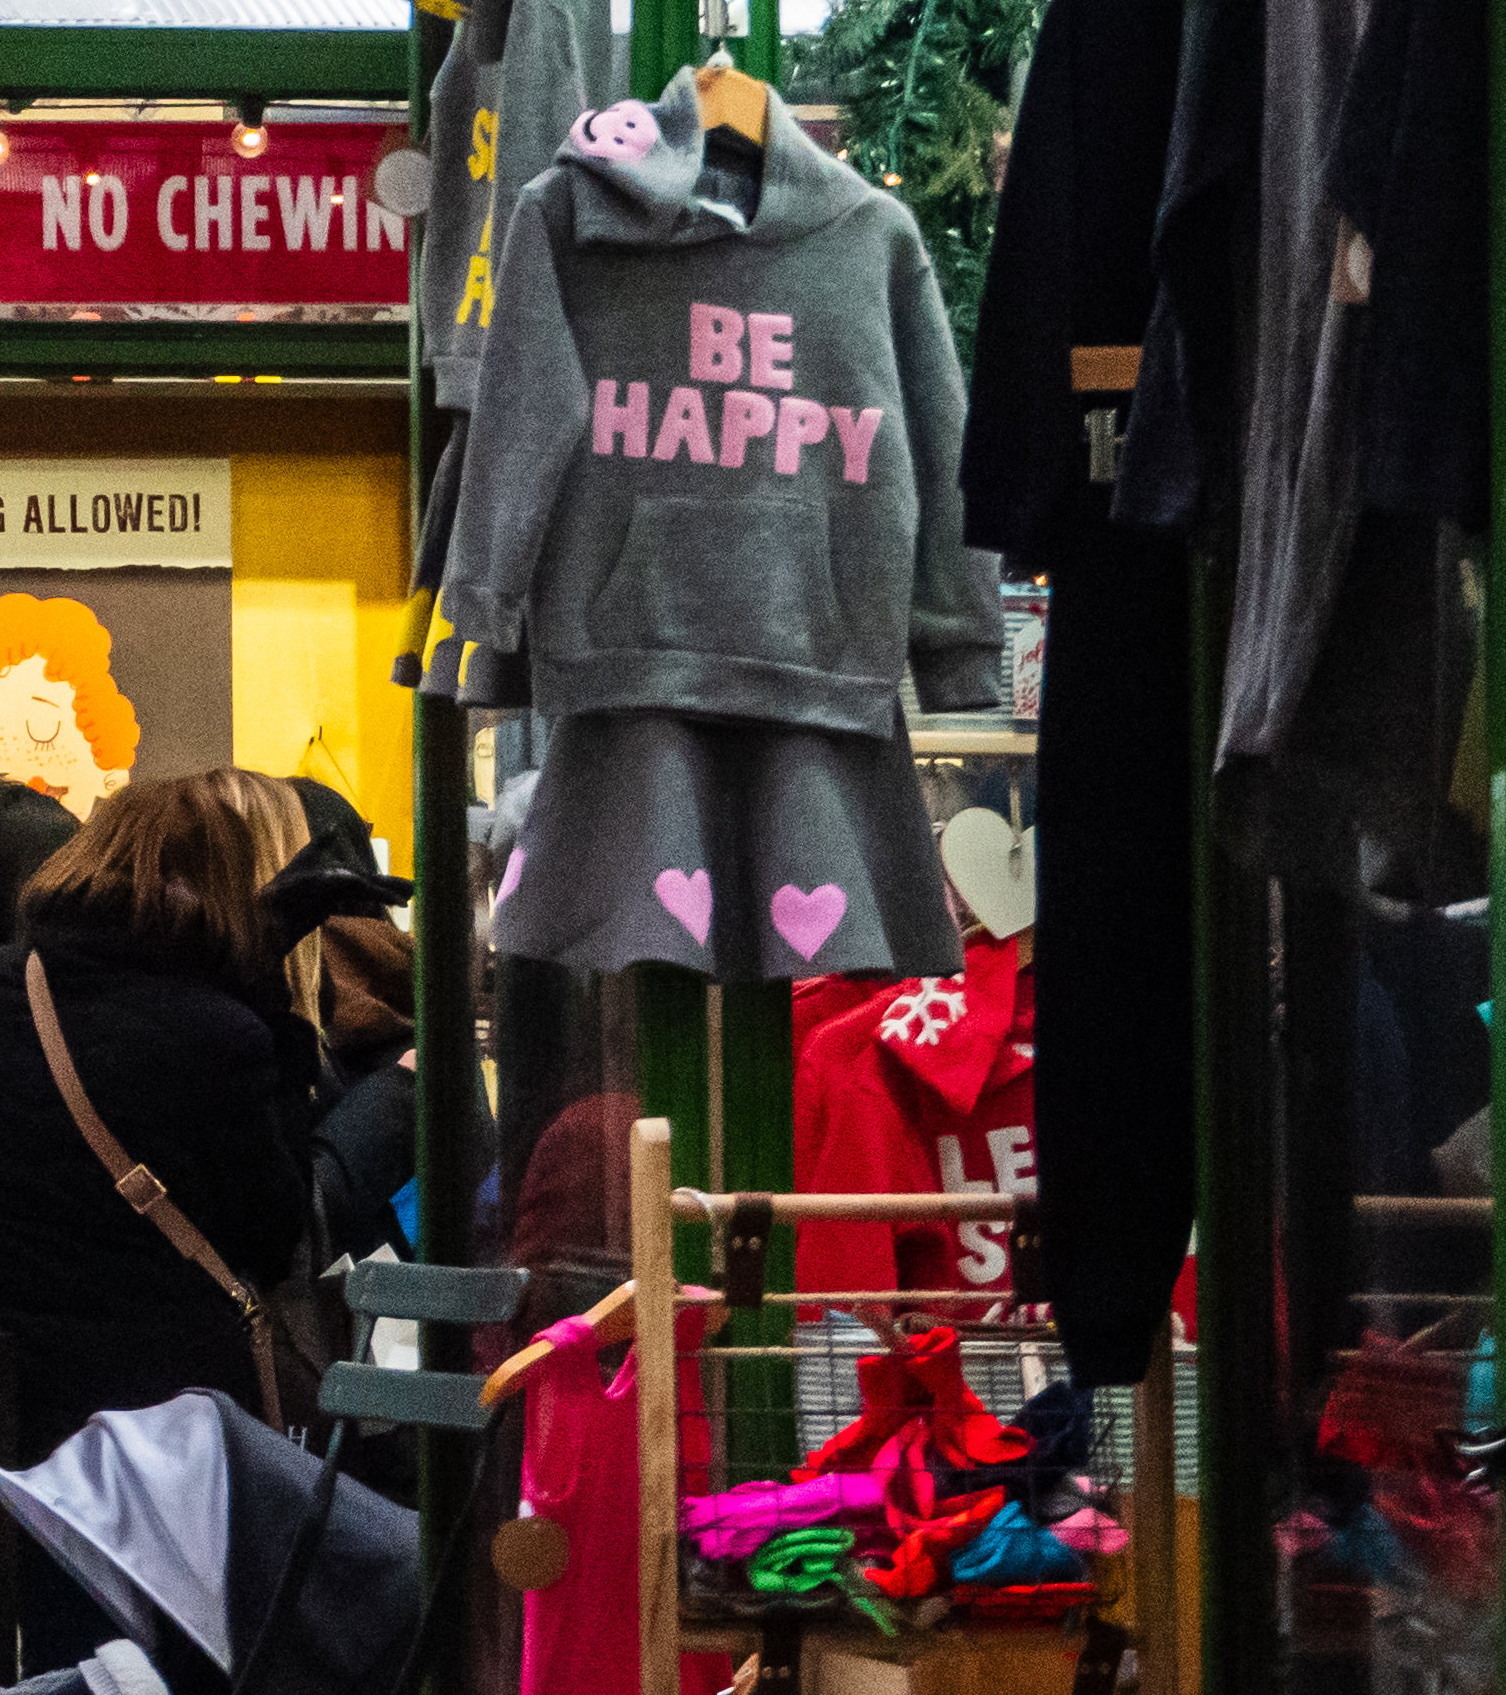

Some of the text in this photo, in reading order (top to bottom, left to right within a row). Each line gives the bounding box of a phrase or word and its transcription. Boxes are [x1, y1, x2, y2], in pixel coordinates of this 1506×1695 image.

[42, 174, 128, 251] NO
[690, 302, 794, 389] BE
[592, 378, 883, 485] HAPPY
[23, 491, 203, 535] ALLOWED!
